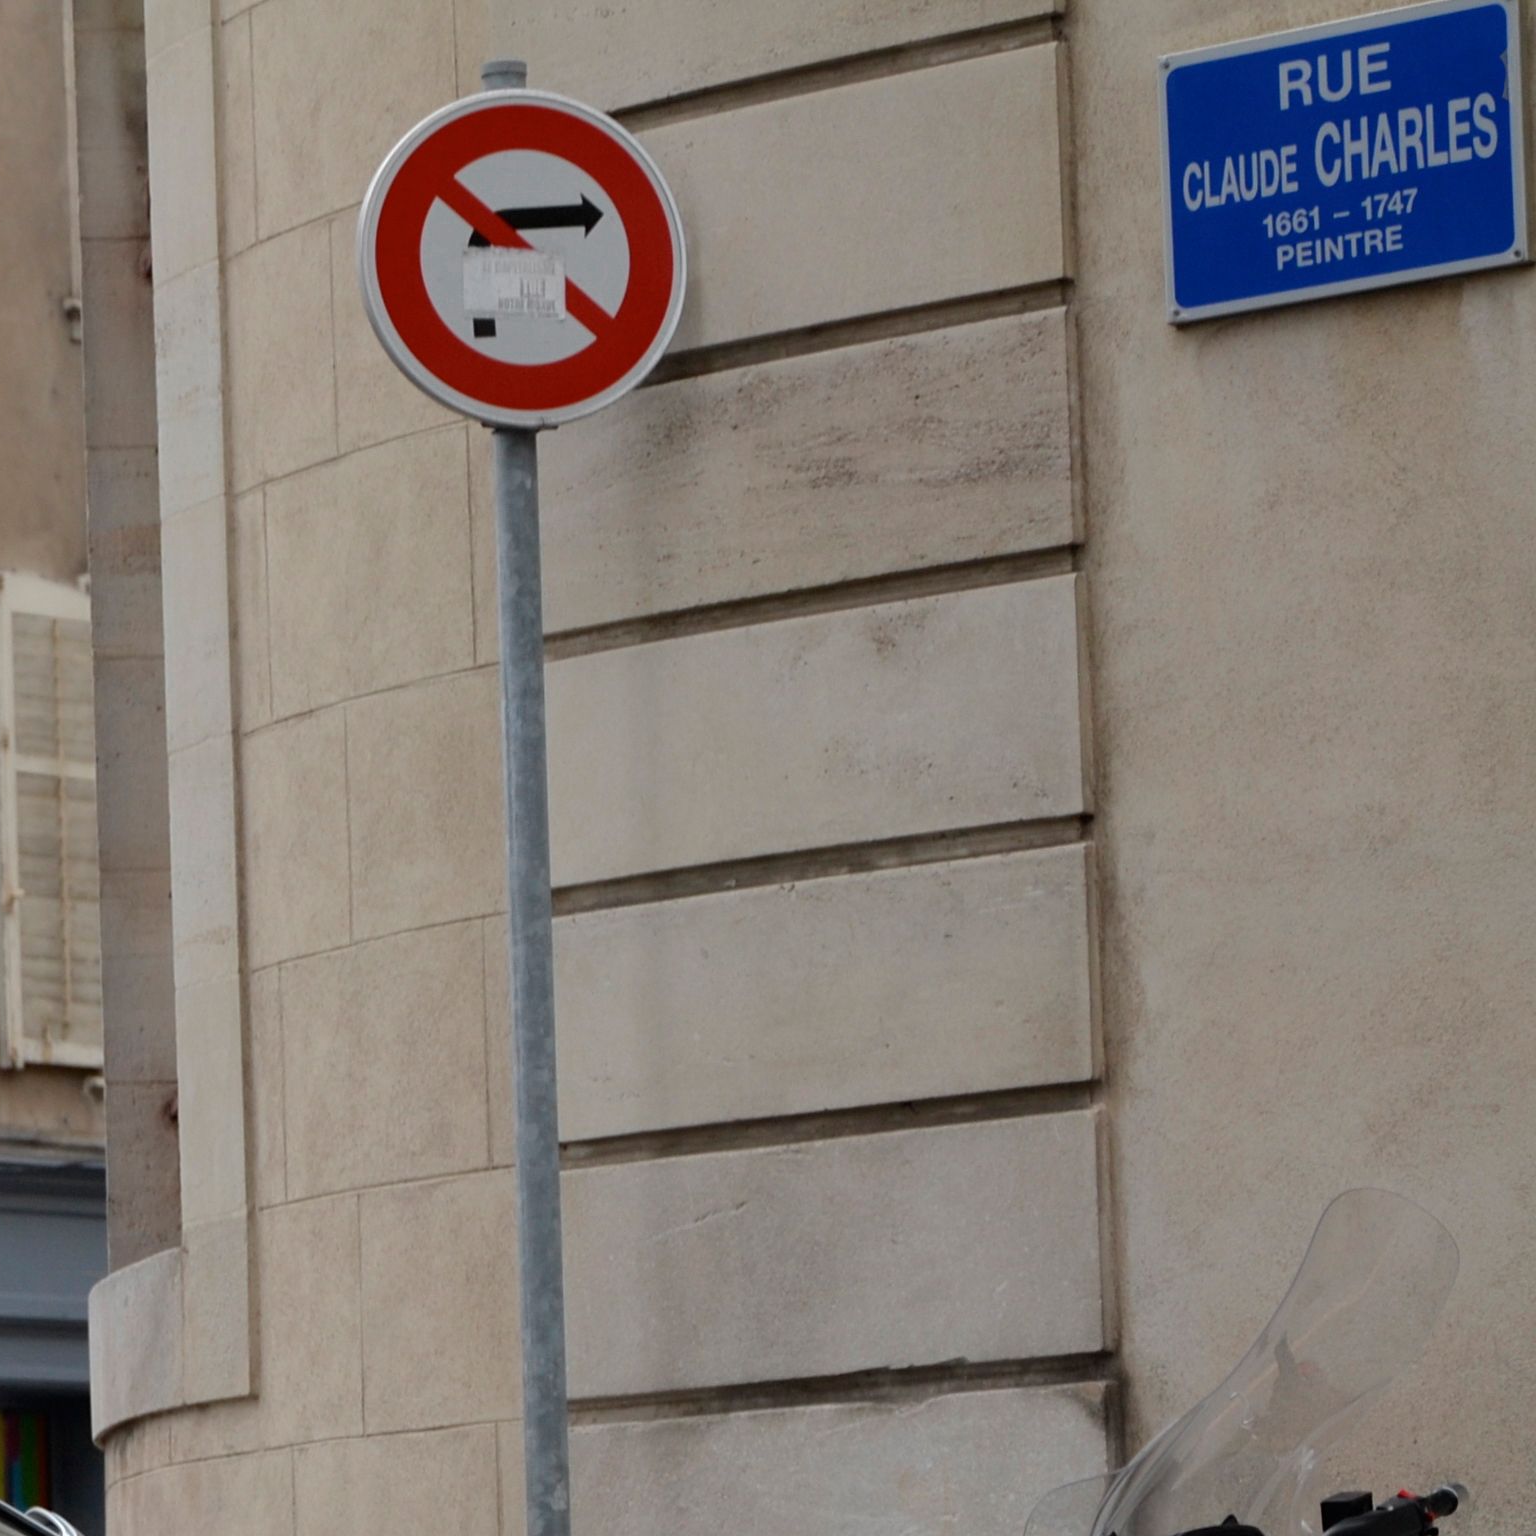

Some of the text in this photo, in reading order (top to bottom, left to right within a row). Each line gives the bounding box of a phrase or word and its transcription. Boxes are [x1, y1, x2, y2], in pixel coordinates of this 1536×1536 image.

[1278, 42, 1392, 111] RUE
[1182, 92, 1498, 212] CLAUDE CHARLES
[1262, 205, 1320, 239] 1661
[1361, 188, 1418, 222] 1747
[1277, 225, 1404, 271] PEINTRE
